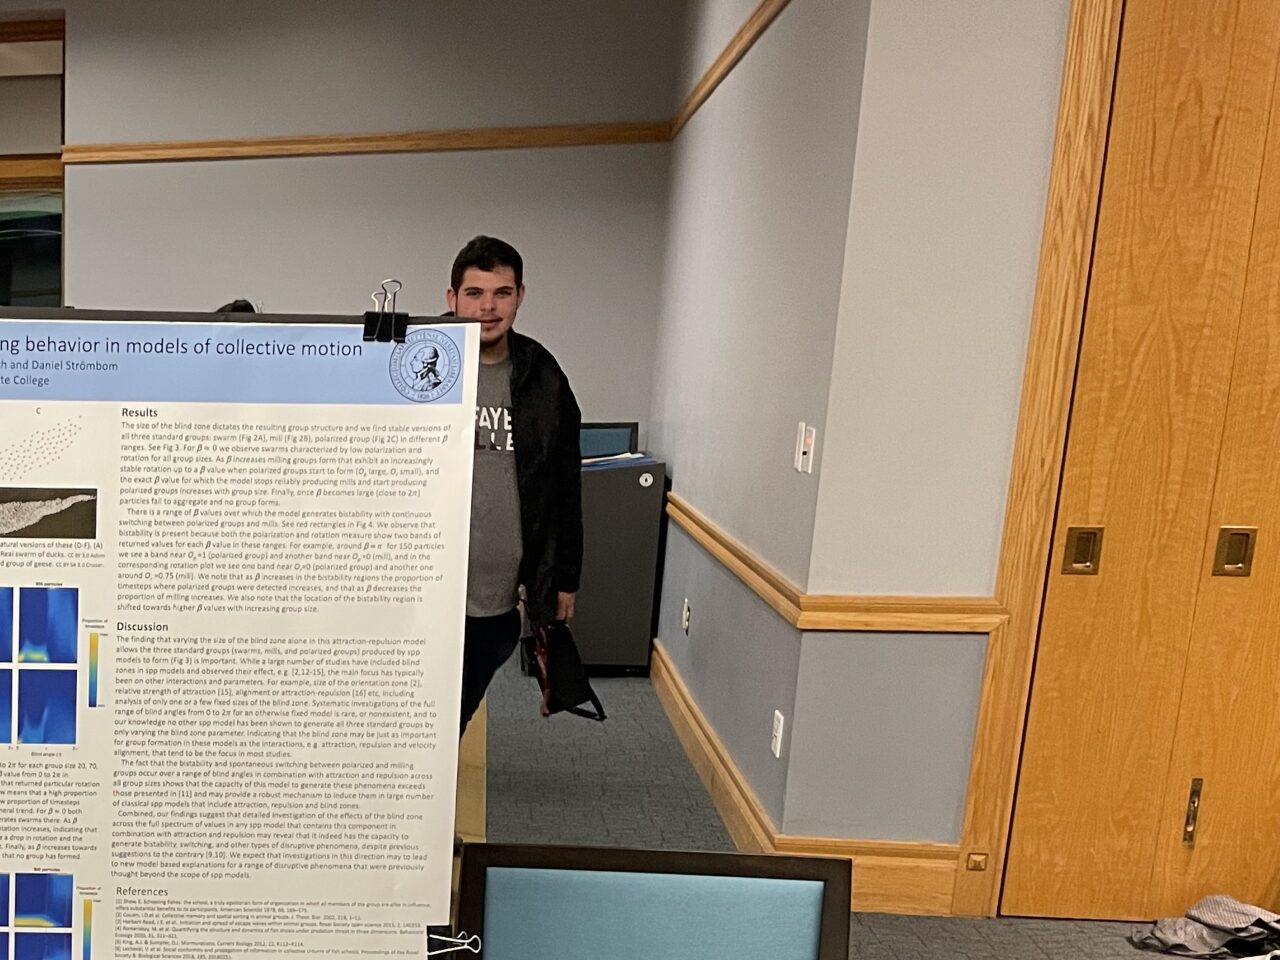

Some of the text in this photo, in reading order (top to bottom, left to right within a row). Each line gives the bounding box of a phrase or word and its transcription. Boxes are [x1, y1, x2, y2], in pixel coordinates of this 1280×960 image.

[26, 333, 100, 352] behavior
[106, 334, 119, 352] in
[126, 334, 187, 353] models
[193, 335, 211, 354] of
[216, 336, 295, 355] collective
[301, 337, 362, 356] motion
[10, 358, 28, 369] and
[31, 359, 63, 370] Daniel
[65, 359, 118, 371] Strömbom
[13, 374, 49, 388] College
[122, 408, 158, 417] Results
[121, 421, 135, 429] The
[136, 421, 149, 429] size
[150, 421, 159, 429] of
[160, 421, 172, 429] the
[174, 421, 192, 429] blind
[212, 421, 240, 430] dictates
[241, 422, 254, 430] the
[255, 422, 286, 432] resulting
[287, 424, 309, 433] group
[310, 422, 343, 431] structure
[344, 422, 358, 431] and
[372, 423, 386, 431] find
[388, 423, 410, 431] stable
[411, 423, 441, 431] versions
[443, 423, 451, 431] of
[119, 496, 150, 507] particles
[151, 497, 162, 505] fail
[163, 497, 171, 505] to
[172, 497, 208, 508] aggregate
[209, 497, 223, 505] and
[235, 499, 256, 508] group
[117, 602, 141, 611] shifted
[142, 603, 171, 611] towards
[172, 603, 195, 614] higher
[203, 604, 226, 612] values
[227, 604, 243, 612] with
[244, 604, 280, 615] increasing
[281, 606, 302, 615] group
[117, 622, 168, 631] Discussion
[116, 635, 129, 643] The
[130, 635, 155, 646] finding
[156, 635, 171, 644] that
[172, 636, 198, 646] varying
[199, 636, 211, 644] the
[213, 636, 226, 644] size
[227, 636, 235, 644] of
[236, 636, 248, 644] the
[250, 636, 268, 644] blind
[287, 636, 307, 644] alone
[309, 636, 316, 644] in
[317, 636, 330, 644] this
[332, 636, 401, 647] attraction-repulsion
[402, 637, 426, 645] model
[110, 869, 138, 880] thought
[139, 870, 165, 880] beyond
[166, 870, 178, 878] the
[180, 872, 200, 881] scope
[201, 870, 209, 878] of
[210, 872, 223, 881] spp
[116, 887, 168, 896] References
